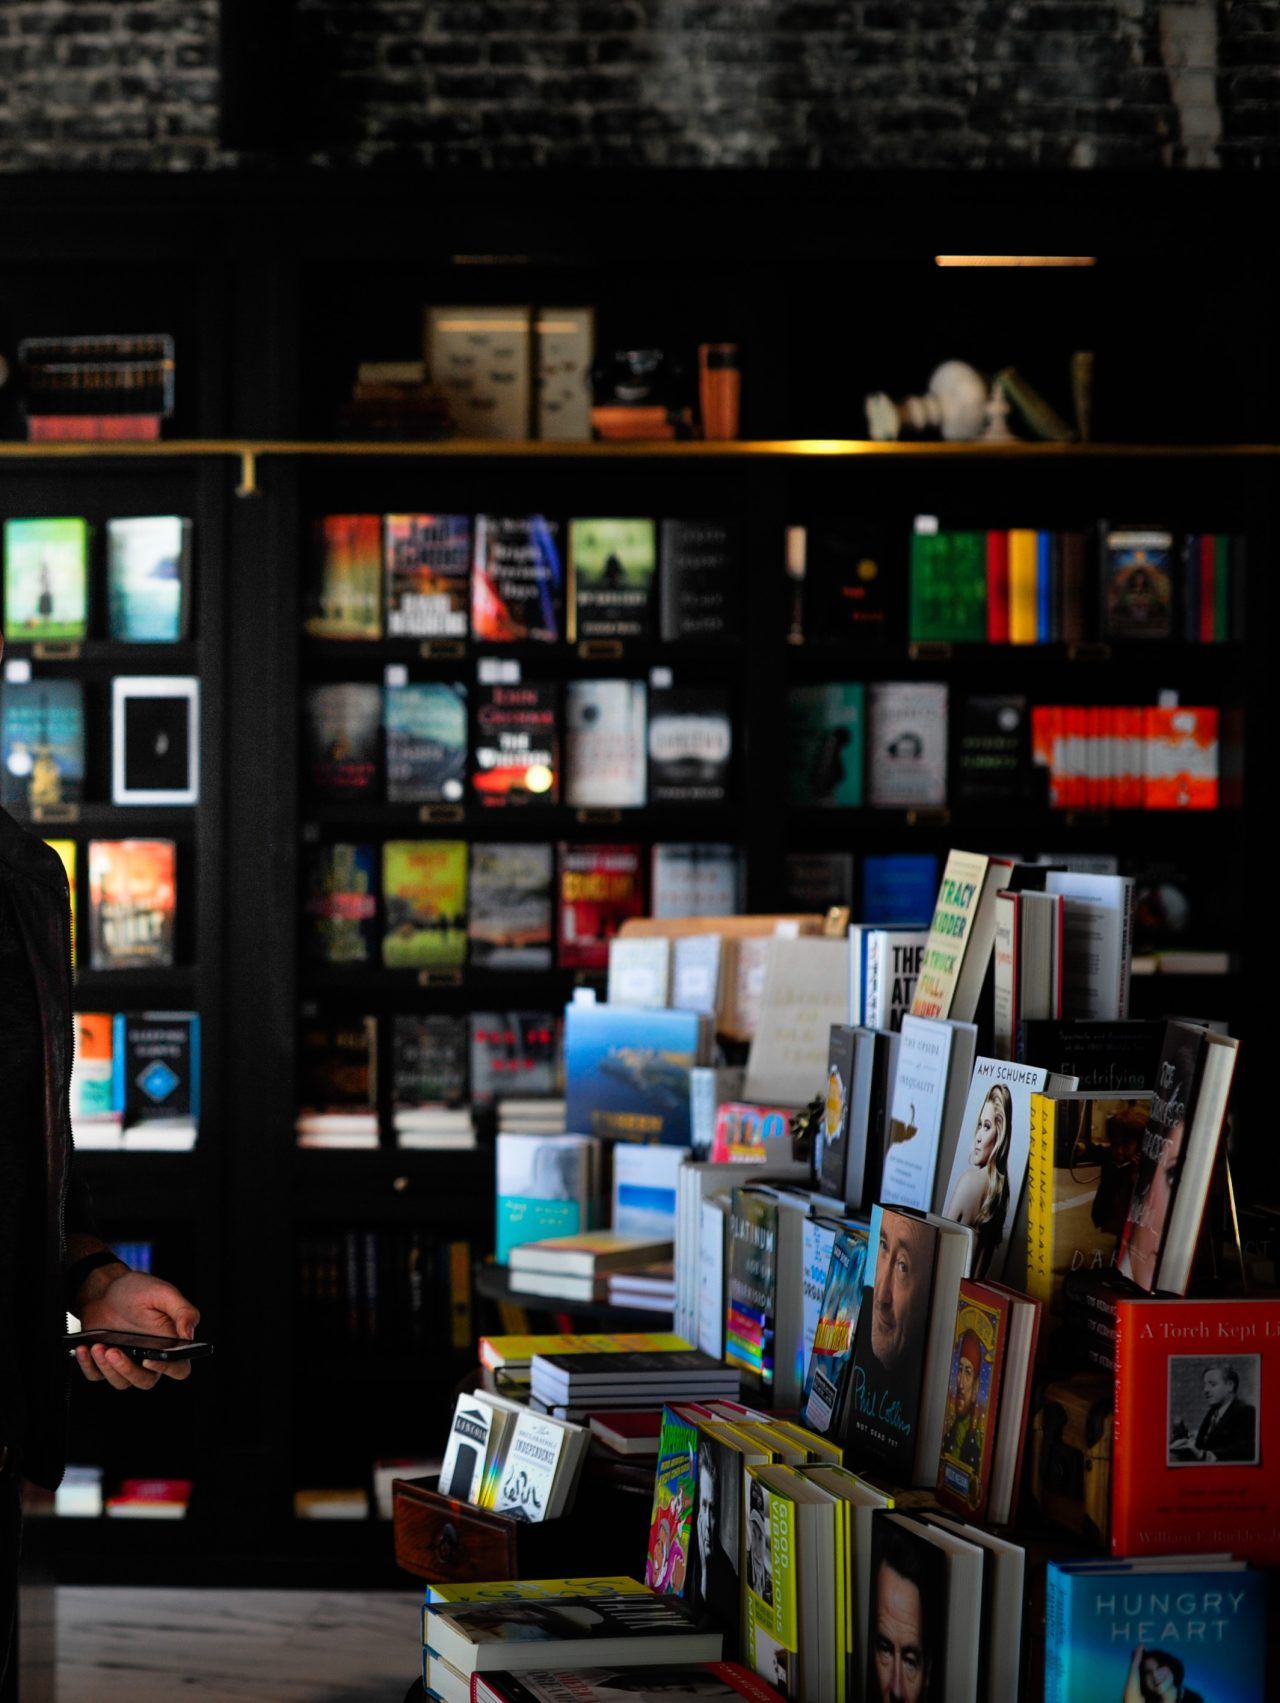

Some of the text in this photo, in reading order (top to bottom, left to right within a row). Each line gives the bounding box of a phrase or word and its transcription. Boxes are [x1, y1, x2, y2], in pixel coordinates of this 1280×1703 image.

[943, 879, 977, 909] TRACY
[932, 911, 967, 938] KIDDER
[892, 946, 924, 973] THE
[977, 1064, 1038, 1086] AMY SCHUMER
[1037, 1108, 1049, 1277] DARLING DAYS
[729, 1213, 774, 1253] PLATINUM
[1139, 1320, 1280, 1343] A Torch Kept Li
[456, 1416, 487, 1444] LINCOLN
[856, 1420, 899, 1448] NOT DEAD YET
[515, 1438, 556, 1466] INDEPENDENCE
[778, 1503, 790, 1570] GOOD
[771, 1500, 784, 1634] VIBRATIONS
[1096, 1591, 1246, 1616] HUNGRY
[1111, 1619, 1229, 1643] HEART
